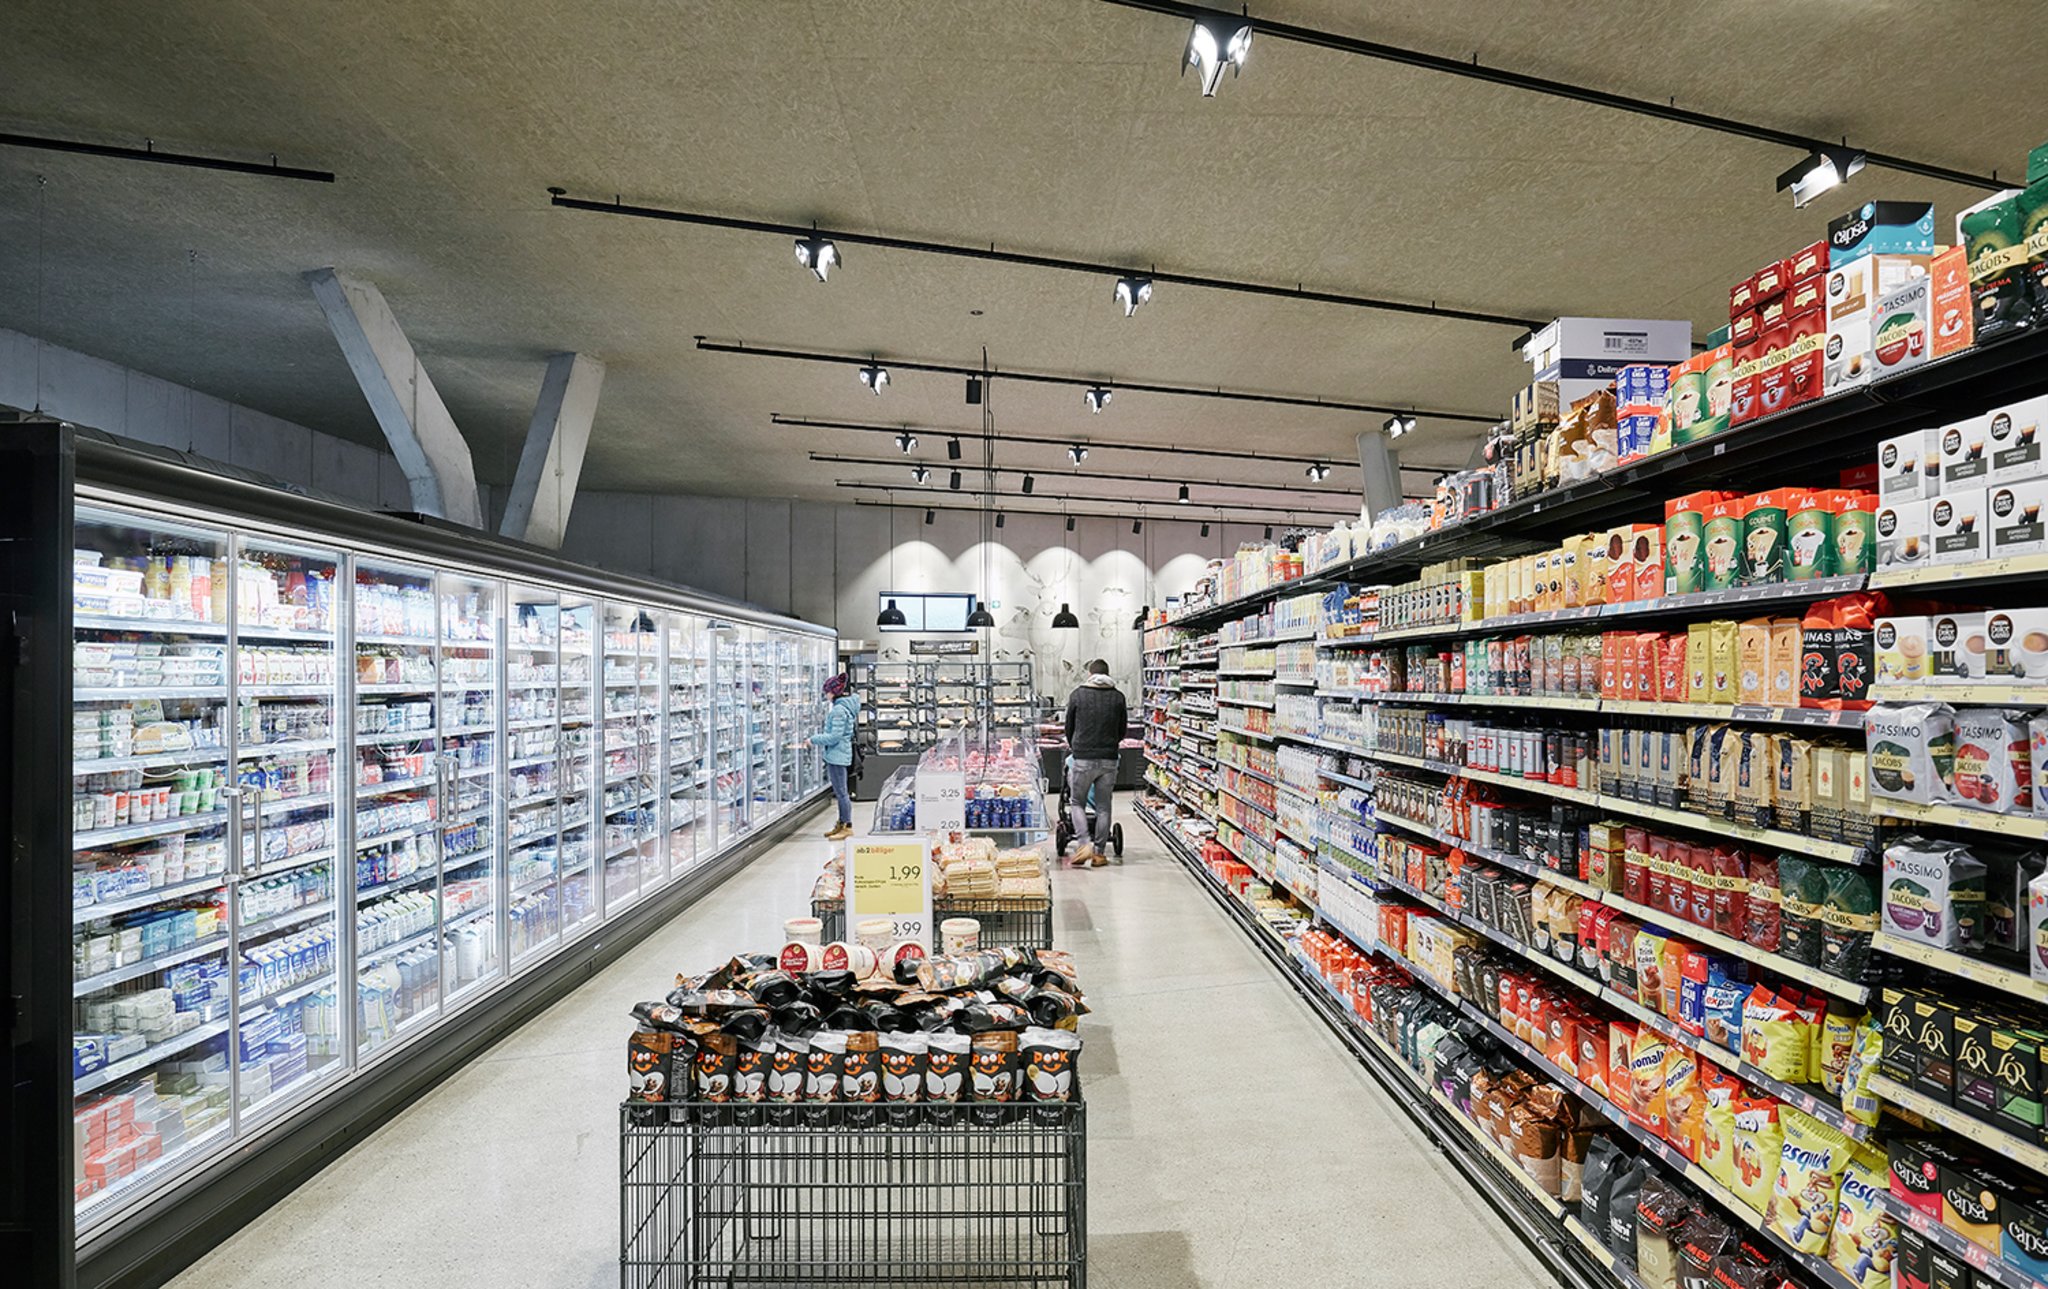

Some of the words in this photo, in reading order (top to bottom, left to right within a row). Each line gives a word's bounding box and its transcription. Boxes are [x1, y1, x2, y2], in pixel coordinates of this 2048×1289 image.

[1970, 252, 2011, 277] JACOBS
[1884, 287, 1926, 313] TASSIMO
[1880, 328, 1907, 345] JACOBS
[1909, 332, 1921, 350] XL
[1788, 338, 1817, 359] JACOBS
[1759, 353, 1786, 372] JACOBS
[1749, 515, 1775, 527] GOURMET
[1875, 724, 1921, 738] TASSIMO
[1961, 725, 2003, 740] TASSIMO
[1874, 756, 1903, 768] JACOBS
[1957, 762, 1982, 773] JACOBS
[940, 789, 960, 799] 3,25
[941, 820, 960, 830] 2,09
[889, 865, 921, 881] 1,99
[1895, 860, 1943, 880] TASSIMO
[1890, 892, 1922, 908] JACOBS
[1922, 911, 1936, 929] XL
[1959, 927, 1970, 938] XL
[1034, 1051, 1069, 1064] POOK
[1782, 1142, 1832, 1172] esquik
